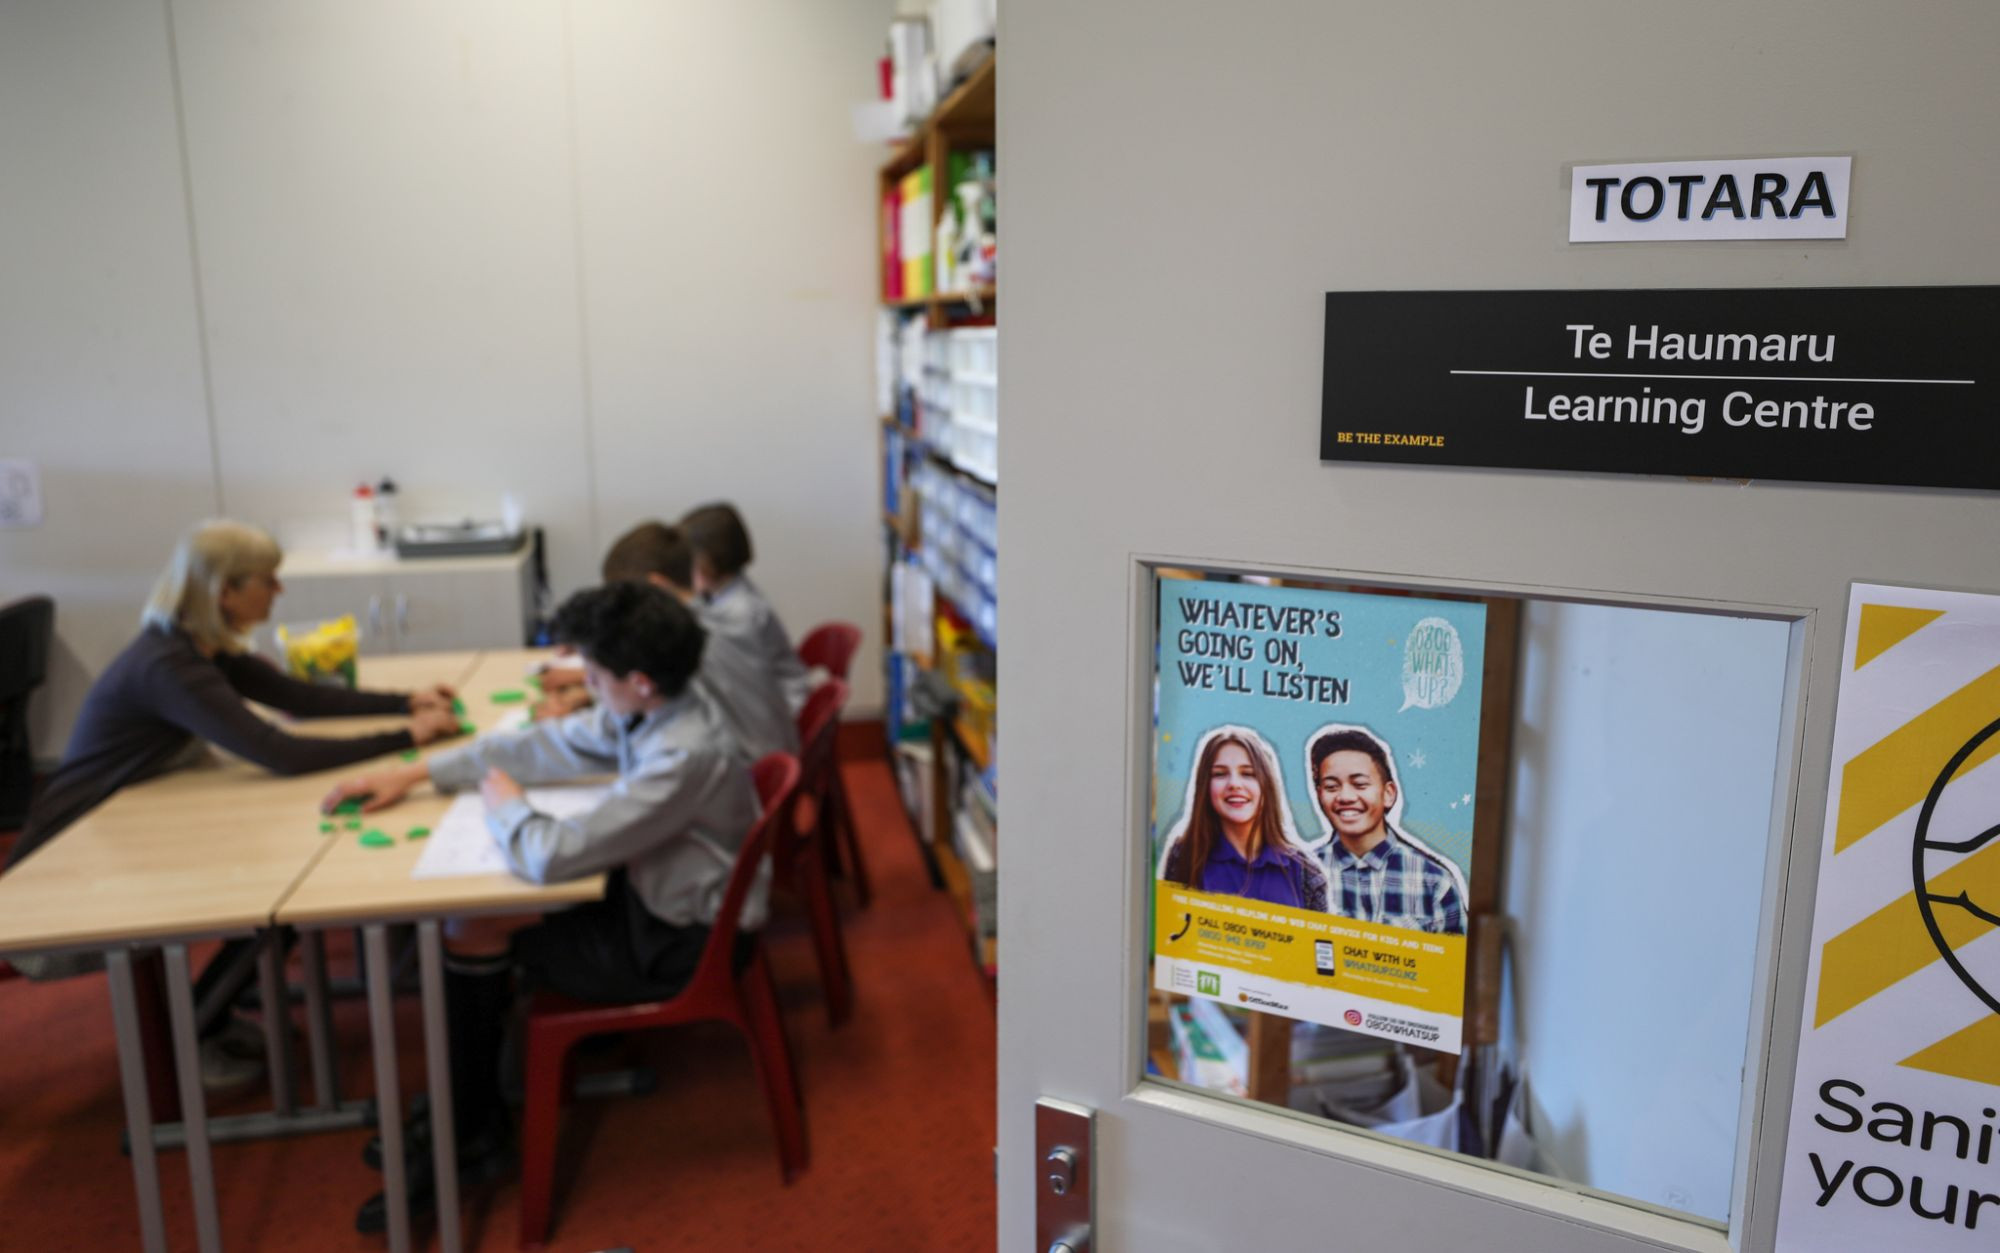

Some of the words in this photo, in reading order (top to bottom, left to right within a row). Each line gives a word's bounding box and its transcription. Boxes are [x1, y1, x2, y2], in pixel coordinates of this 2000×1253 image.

[1584, 170, 1837, 223] TOTARA
[1565, 324, 1612, 359] Te
[1626, 324, 1836, 362] Haumaru
[1523, 385, 1706, 435] Learning
[1721, 391, 1876, 431] Centre
[1336, 431, 1353, 443] BE
[1356, 432, 1382, 445] THE
[1384, 433, 1445, 448] EXAMPLE
[1177, 596, 1343, 638] WHATEVER'S
[1178, 629, 1254, 661] GOING
[1263, 637, 1304, 674] ON,
[1177, 660, 1253, 694] WE'LL
[1262, 669, 1350, 705] LISTEN
[1417, 675, 1449, 705] UP?
[1197, 916, 1220, 929] CALL
[1223, 921, 1248, 935] 0800
[1250, 927, 1294, 943] WHATSUP
[1380, 934, 1399, 946] KIDS
[1343, 946, 1368, 959] CHAT
[1372, 951, 1400, 966] WITH
[1403, 957, 1417, 969] US
[1365, 1018, 1440, 1043] 0800WHATSUP
[1814, 1078, 2000, 1165] Sani
[1808, 1152, 2000, 1230] your
